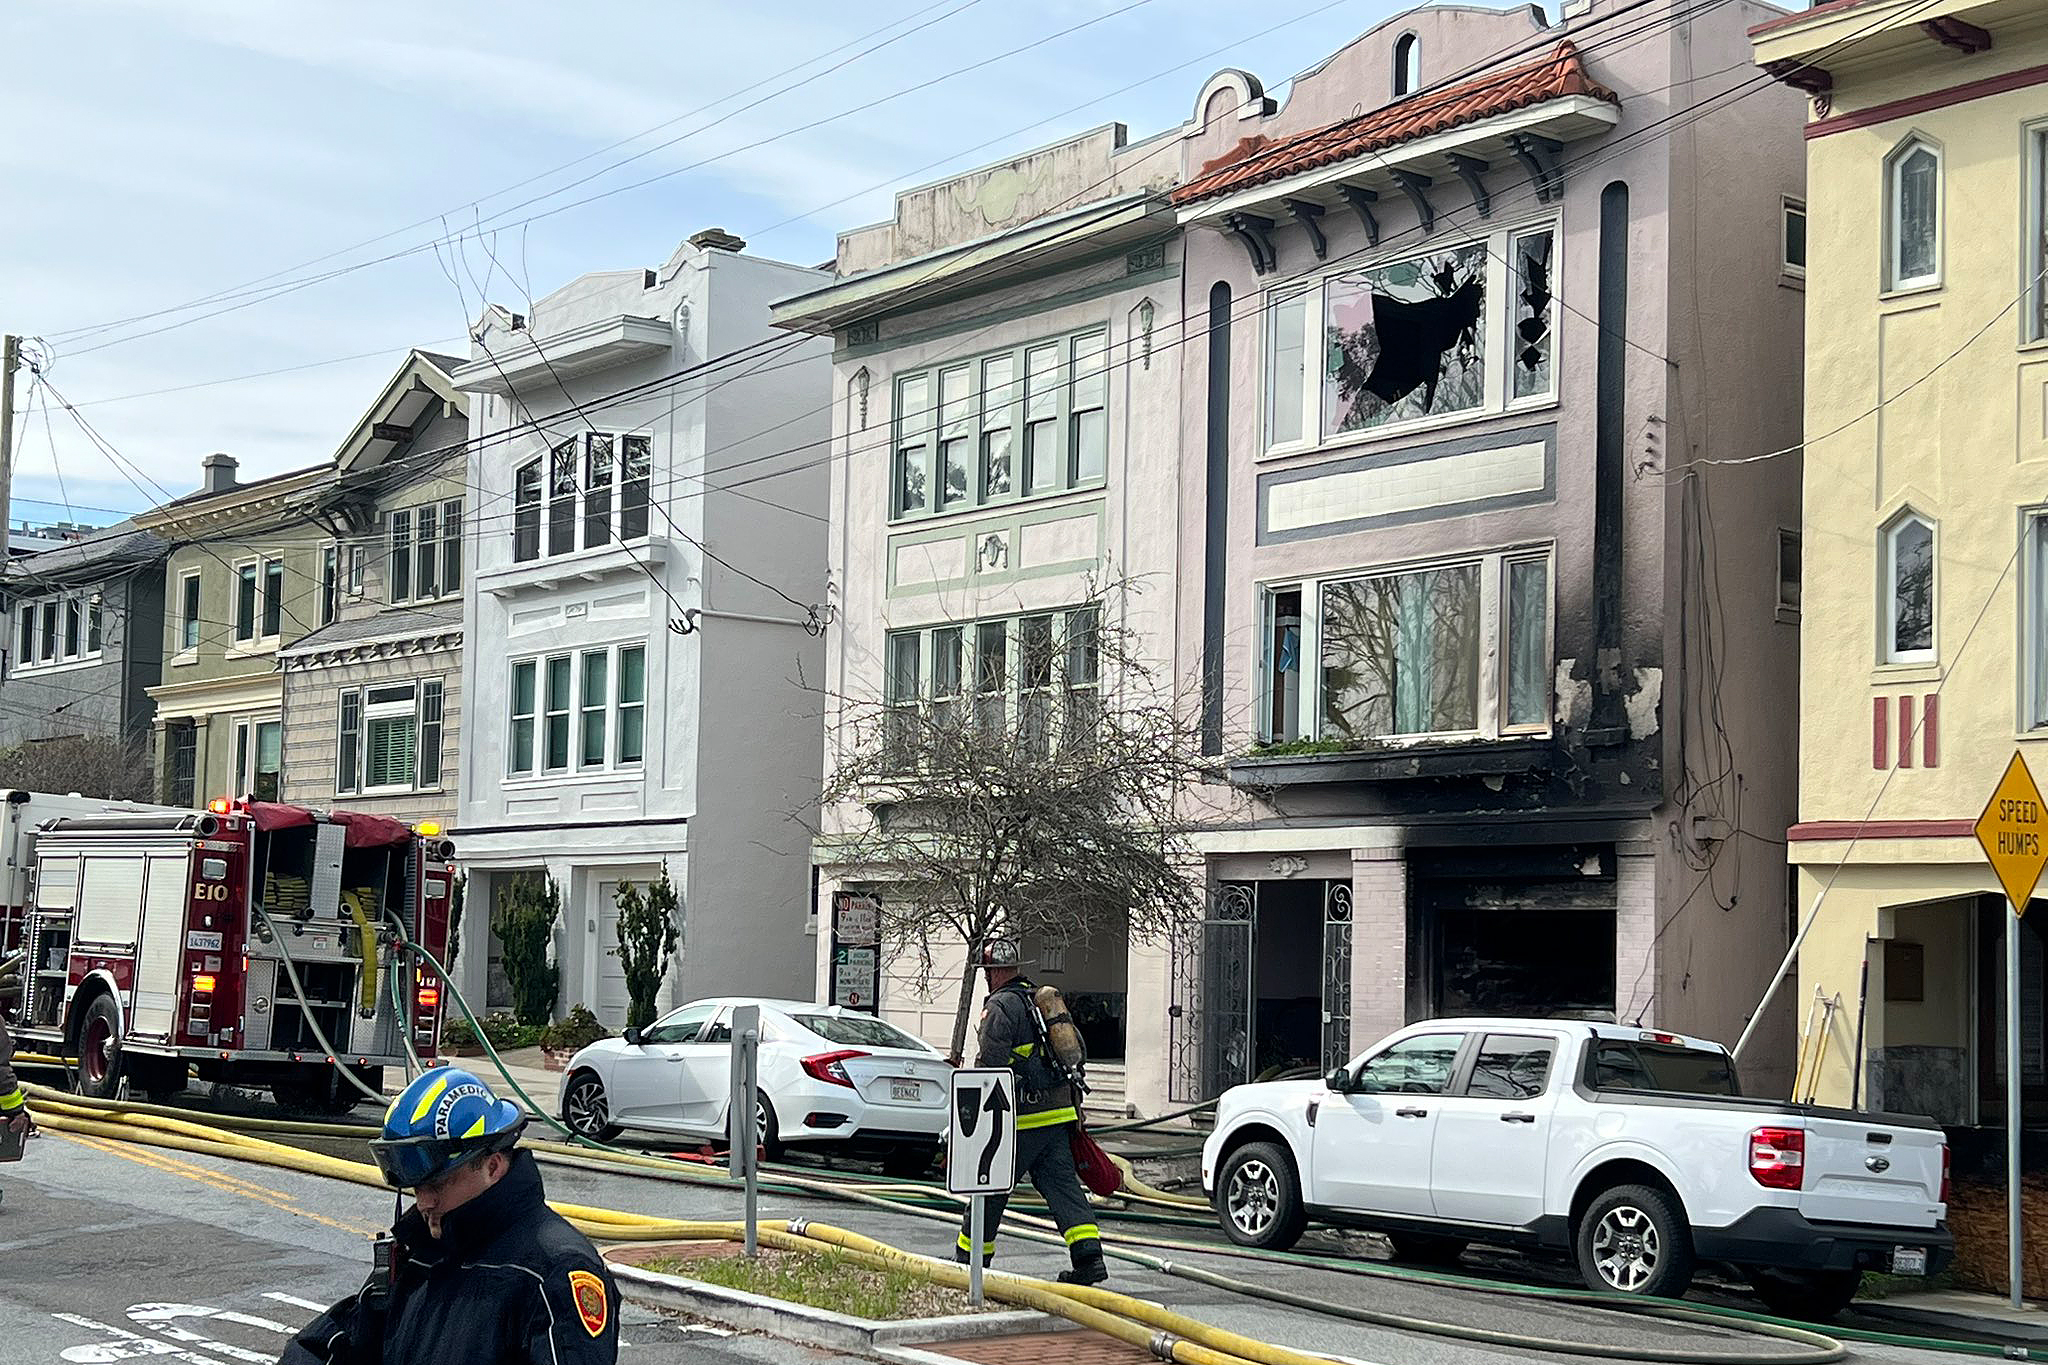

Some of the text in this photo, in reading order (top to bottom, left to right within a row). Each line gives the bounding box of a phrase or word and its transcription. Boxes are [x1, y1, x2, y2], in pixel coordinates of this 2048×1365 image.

[1999, 799, 2038, 824] SPEED
[1998, 831, 2039, 856] HUMPS
[194, 882, 229, 902] E10
[838, 950, 846, 963] 2
[437, 1085, 488, 1136] PARAMEDIC
